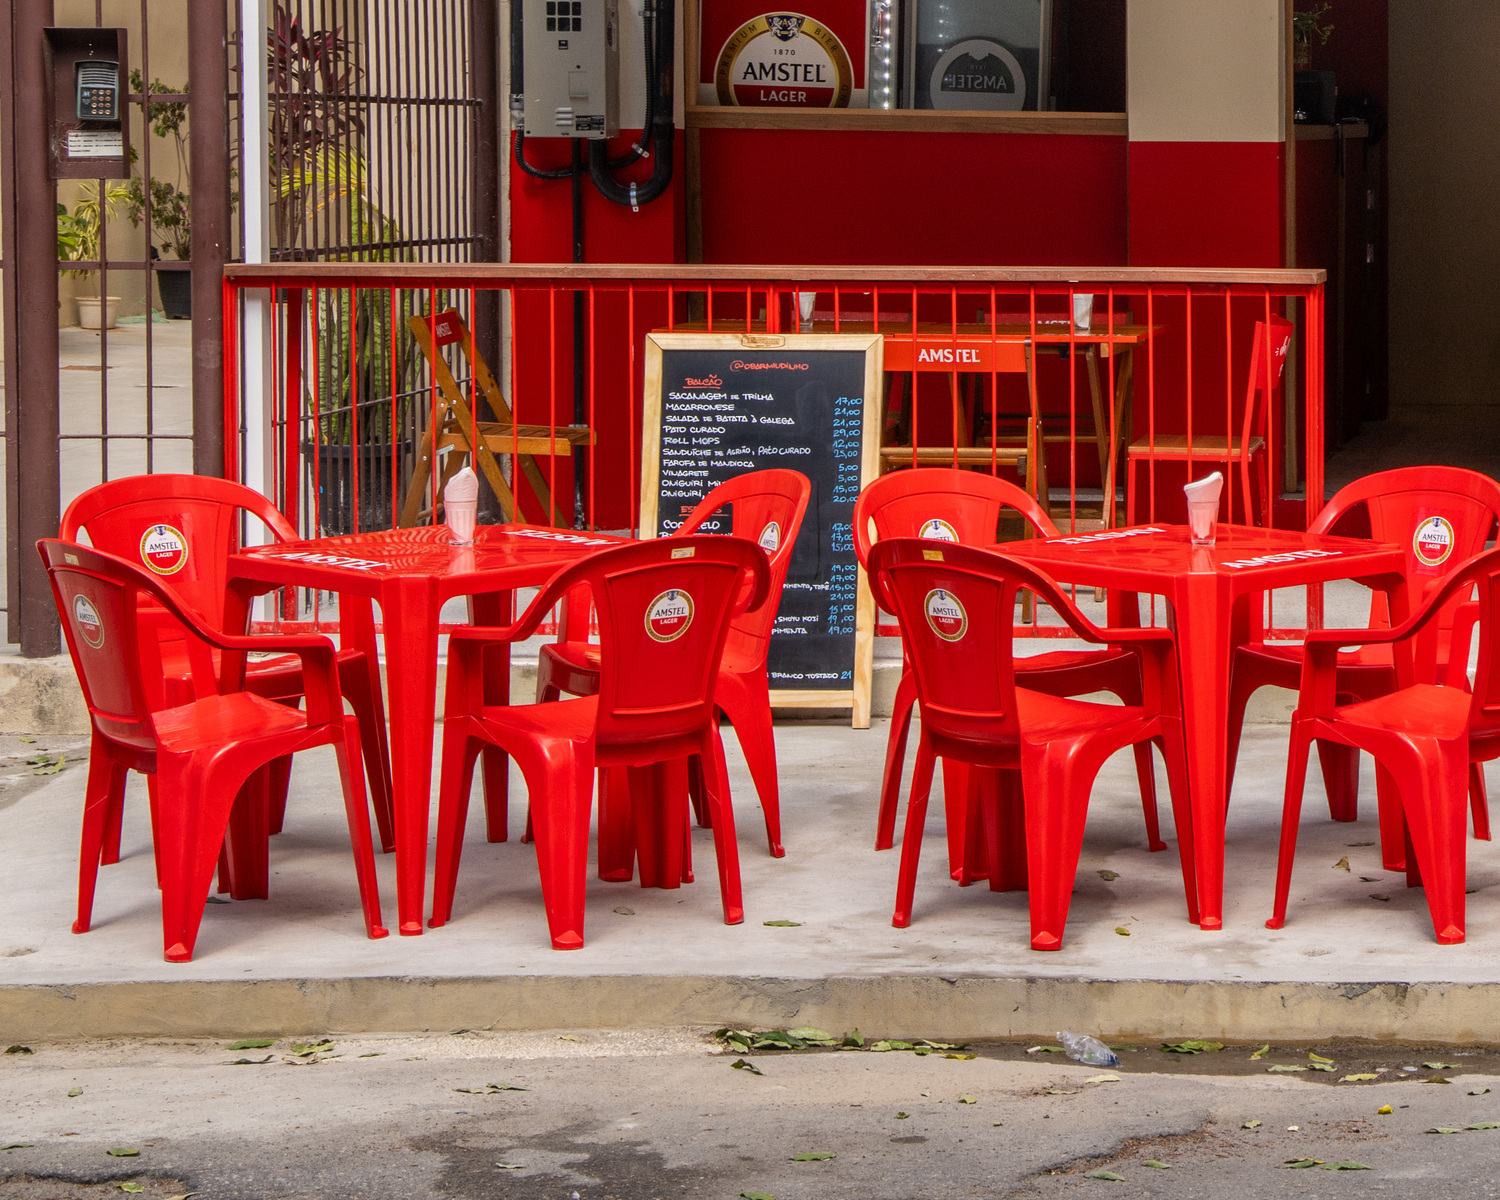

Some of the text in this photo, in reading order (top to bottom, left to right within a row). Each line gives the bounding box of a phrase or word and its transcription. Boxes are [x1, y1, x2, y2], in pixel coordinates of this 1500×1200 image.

[719, 24, 839, 76] PREMIUM BIER
[742, 61, 827, 83] AMSTEL
[760, 89, 807, 102] LAGER
[917, 348, 981, 362] AMSTEL
[684, 374, 723, 387] BALCÃO
[668, 391, 727, 400] SACANAGEM
[742, 392, 774, 401] TRILHA
[665, 403, 735, 411] MACARRONESE
[715, 414, 748, 423] BATATA
[760, 416, 795, 425] GALEGA
[662, 425, 686, 434] PATO
[689, 426, 726, 434] CURADO
[692, 437, 720, 445] MOPS
[778, 447, 811, 455] CURADO
[662, 459, 696, 467] FAROFA
[838, 464, 859, 472] 5,00
[661, 479, 703, 488] ONIGUIRI
[837, 474, 858, 483] 5,00
[1421, 533, 1448, 543] AMSTEL
[150, 541, 179, 551] AMSTEL
[654, 606, 686, 617] AMSTEL
[932, 606, 960, 617] AMSTEL
